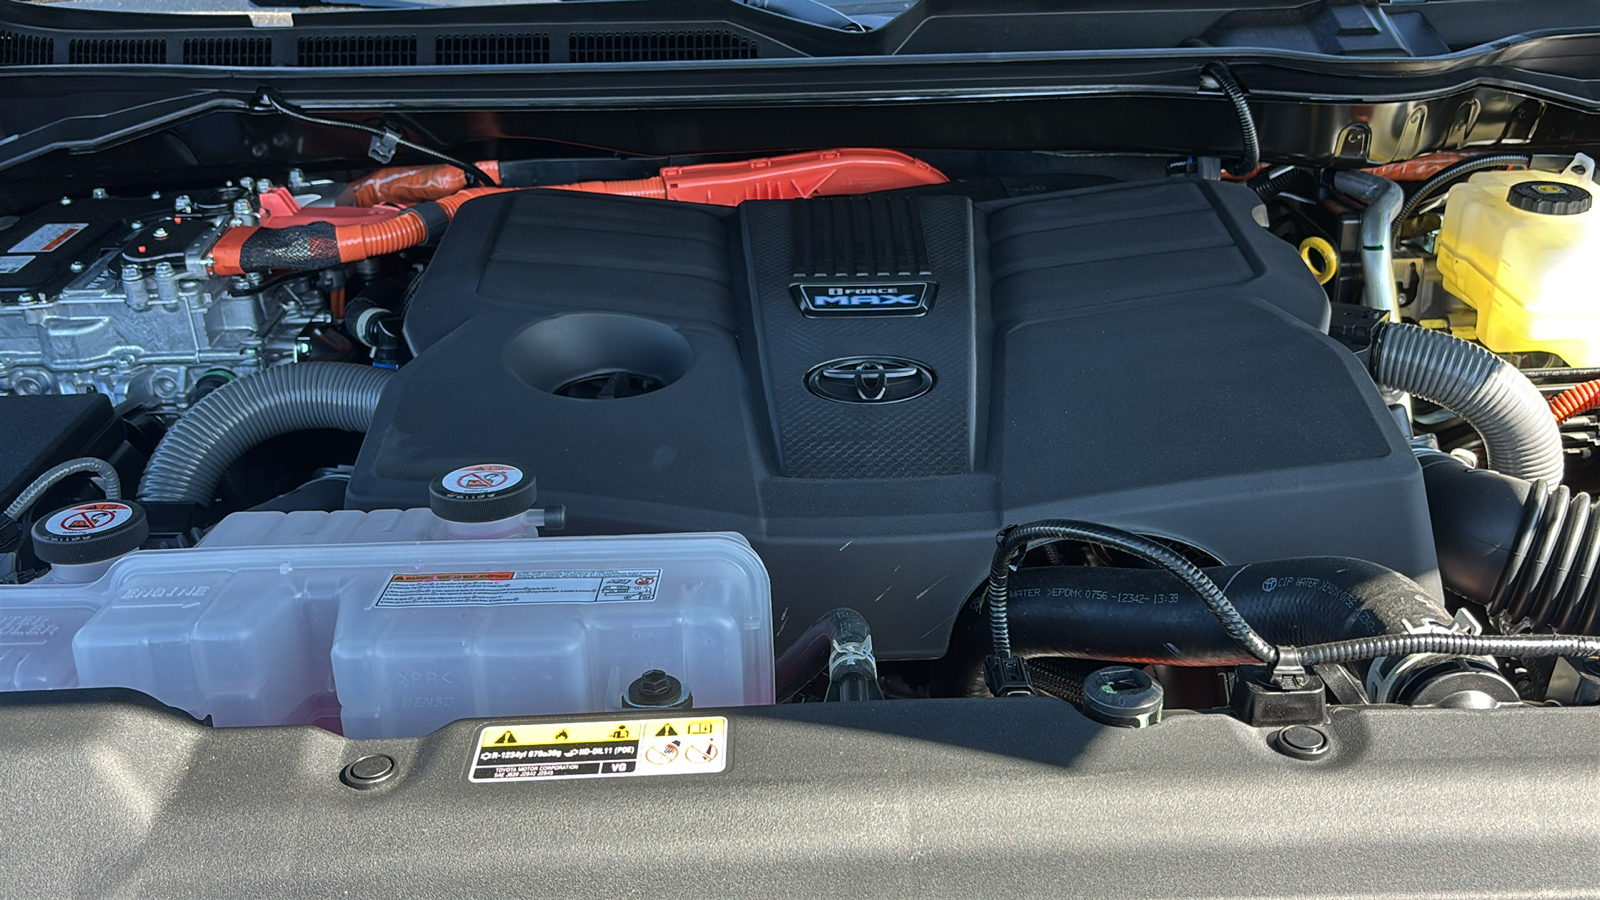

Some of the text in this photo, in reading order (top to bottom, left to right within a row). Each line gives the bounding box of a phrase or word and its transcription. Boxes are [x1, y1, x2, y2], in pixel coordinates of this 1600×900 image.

[814, 294, 917, 305] MAX
[121, 586, 210, 600] ENGINE
[1085, 589, 1108, 601] 0756
[611, 762, 627, 772] VG
